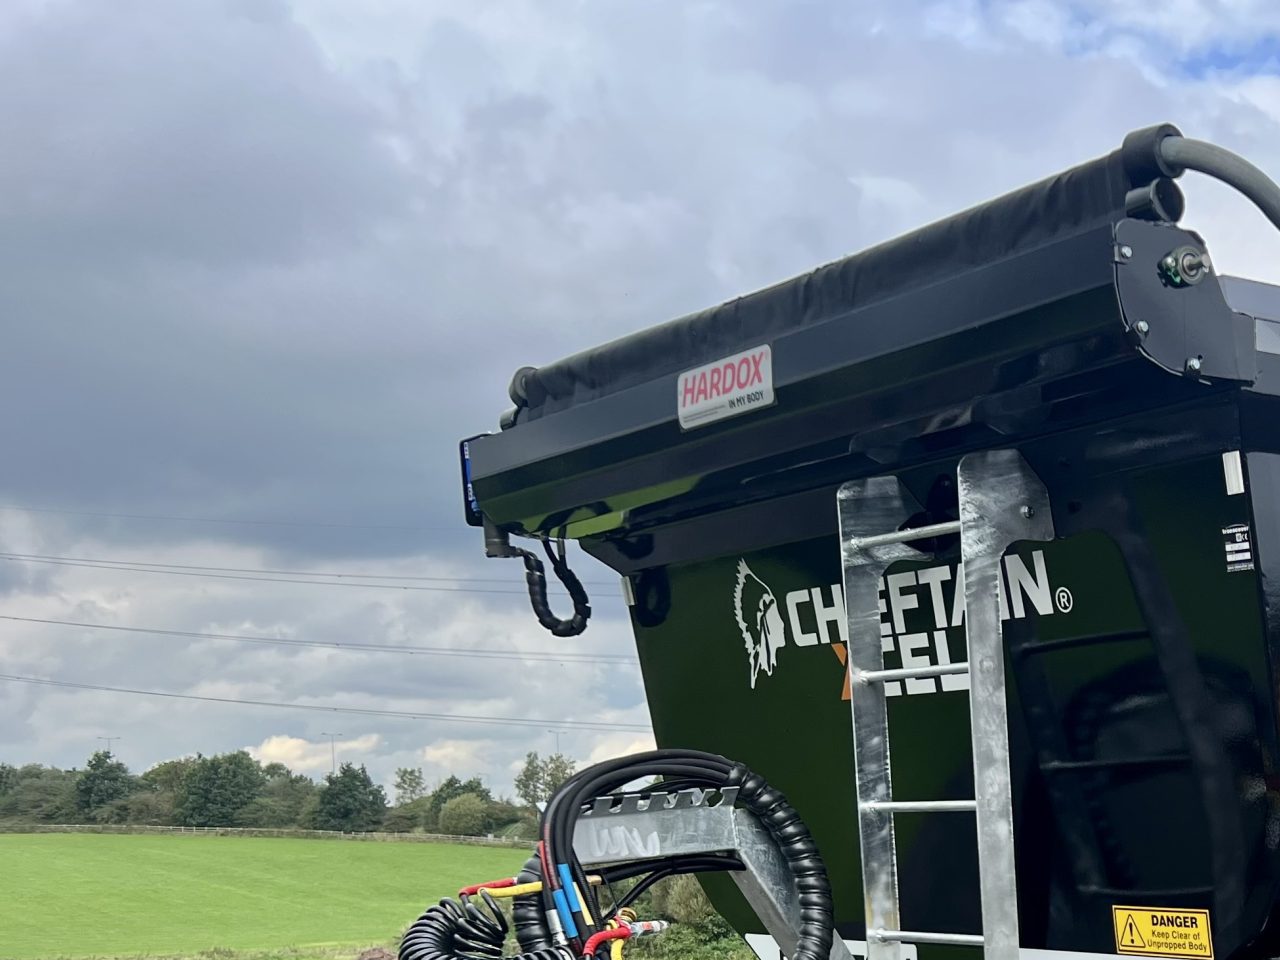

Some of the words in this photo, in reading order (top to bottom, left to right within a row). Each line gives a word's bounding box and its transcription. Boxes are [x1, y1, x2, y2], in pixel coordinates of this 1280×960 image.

[682, 351, 764, 409] HARDOX
[728, 399, 736, 409] IN
[736, 396, 746, 407] MY
[747, 391, 764, 404] BODY
[1151, 914, 1199, 929] DANGER
[1151, 929, 1170, 940] Keep
[1171, 930, 1191, 940] Clear
[1192, 931, 1201, 940] of
[1147, 939, 1187, 951] Unpropped
[1188, 941, 1207, 952] Body
